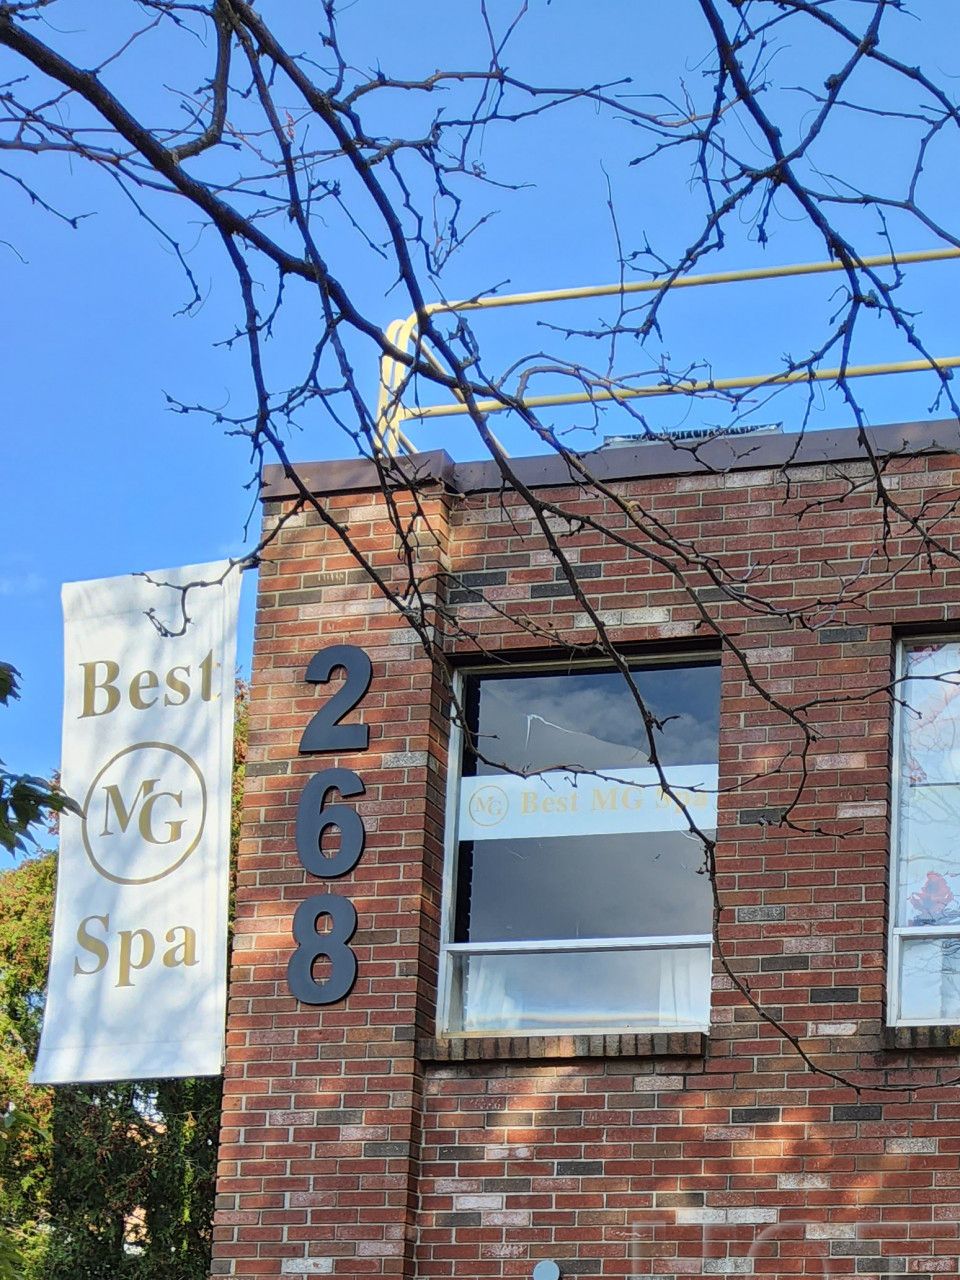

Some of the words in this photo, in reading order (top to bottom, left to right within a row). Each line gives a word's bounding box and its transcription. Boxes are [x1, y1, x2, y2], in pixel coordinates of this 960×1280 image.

[77, 649, 221, 719] Best
[99, 779, 187, 845] MG
[287, 644, 374, 1006] 268
[521, 791, 579, 814] Best
[592, 788, 642, 810] MG
[73, 913, 200, 987] Spa
